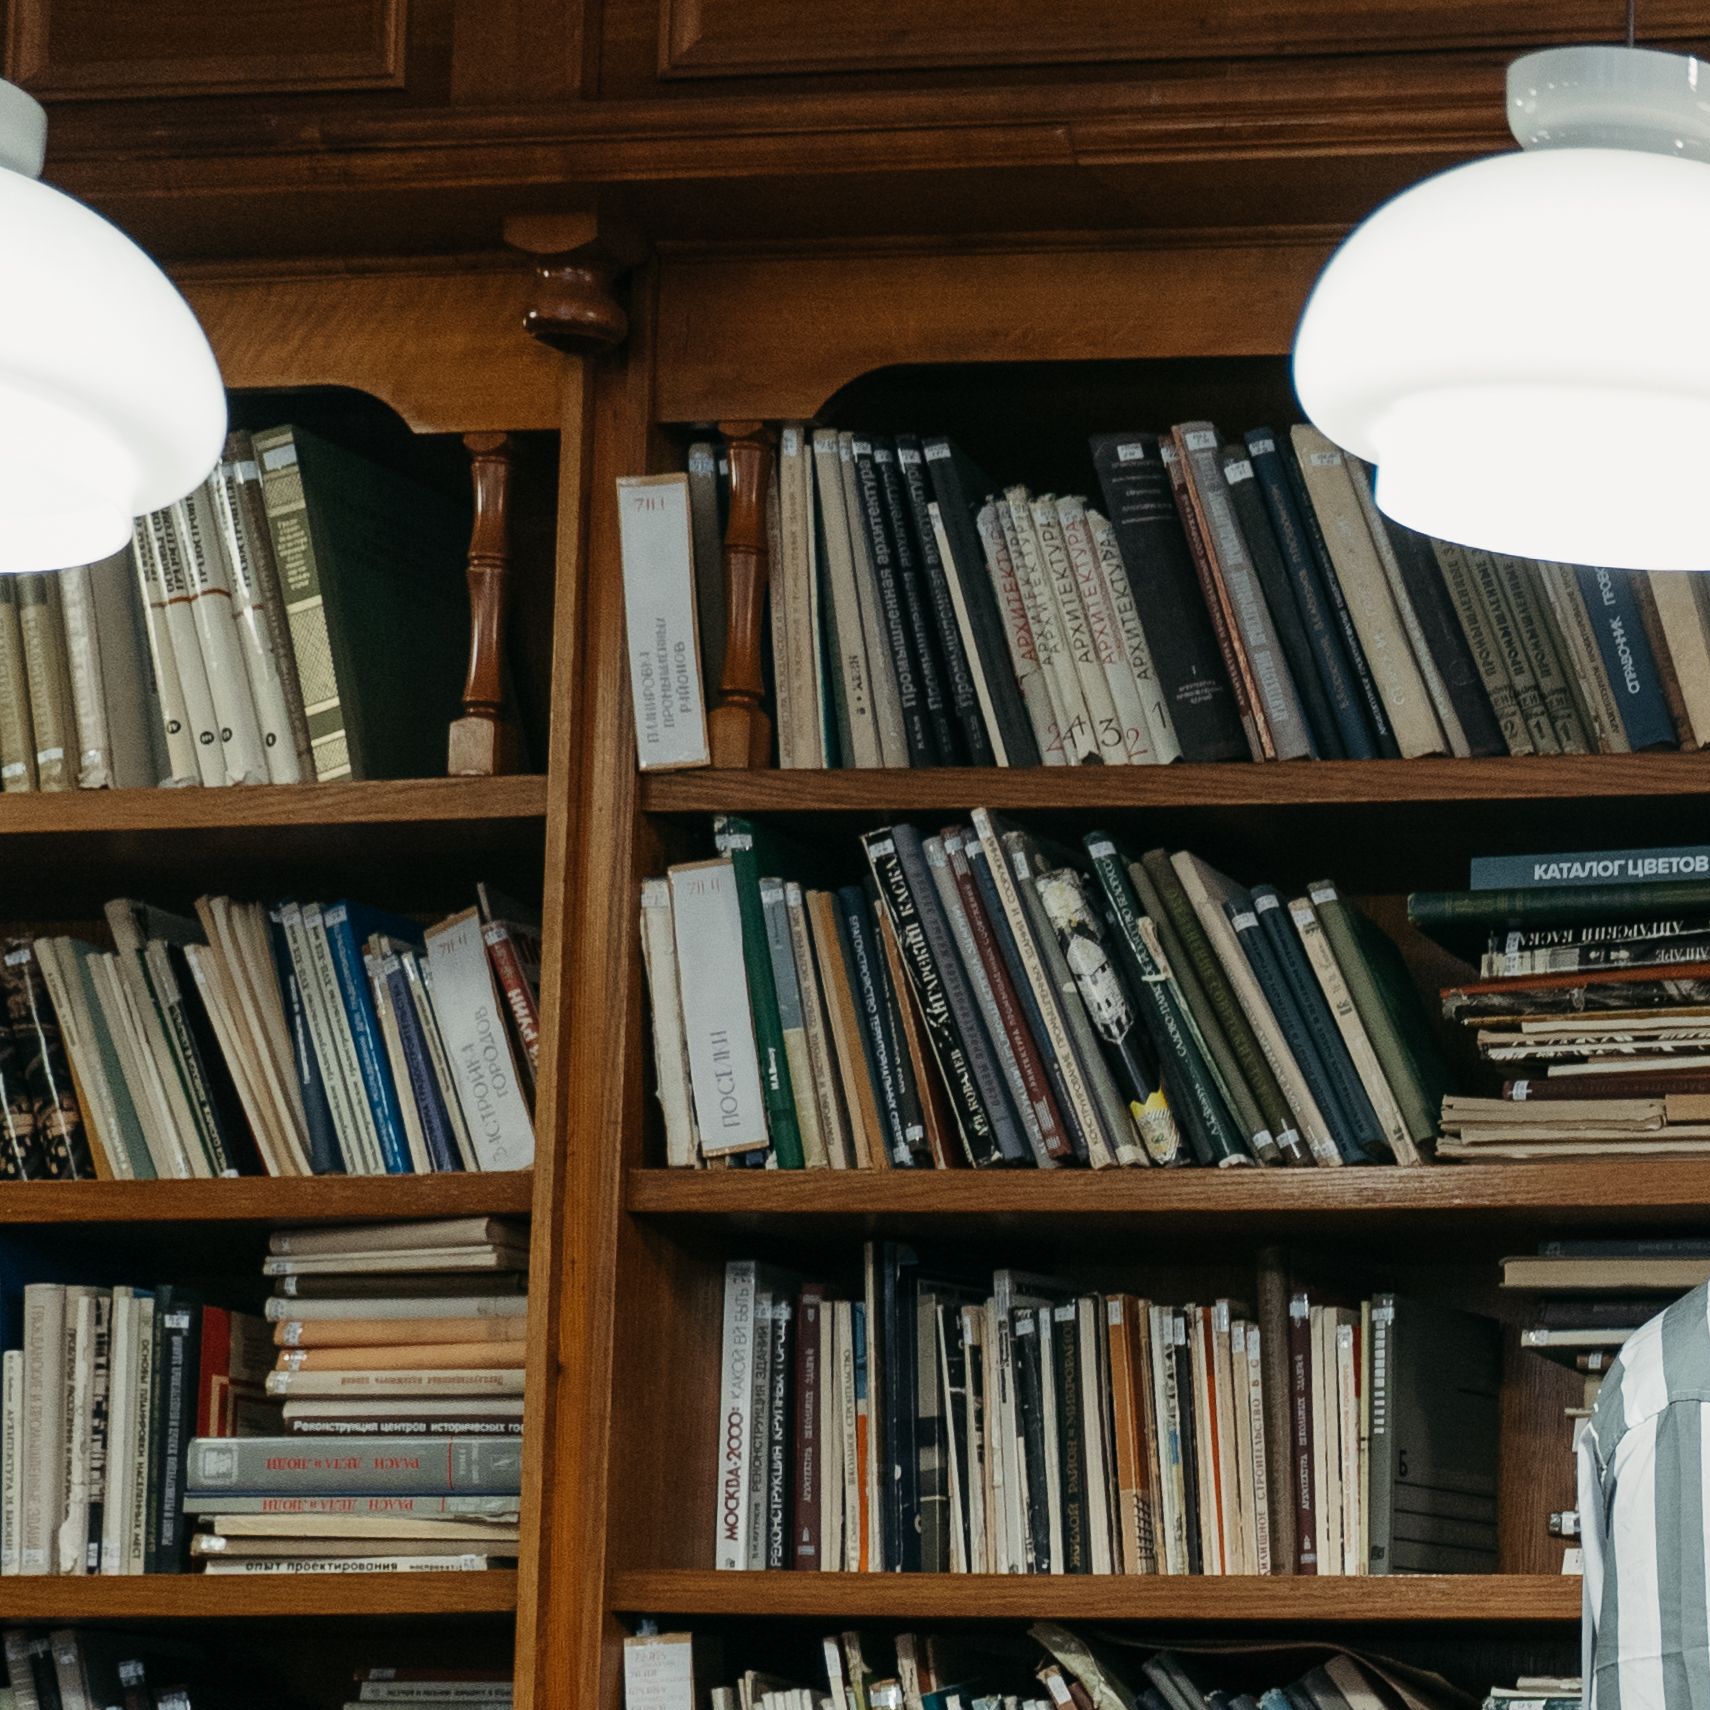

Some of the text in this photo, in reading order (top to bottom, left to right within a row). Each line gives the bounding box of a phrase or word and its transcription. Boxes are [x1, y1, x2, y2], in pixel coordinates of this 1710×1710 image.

[879, 568, 918, 709] Промышленная
[1099, 537, 1152, 681] АРХИТЕКТУРА
[1447, 559, 1497, 676] ПРОМЫШЛЕННЫЕ
[1475, 560, 1525, 676] ПРОМЫШЛЕННЫЕ
[1609, 616, 1641, 694] СПРАВОЧНИК
[1533, 860, 1624, 881] КАТАЛОГ
[1627, 855, 1709, 878] ЦВЕТОВ
[293, 1420, 378, 1434] Реконструкция
[380, 1421, 426, 1434] центров
[751, 1325, 769, 1493] РЕКОНСТРУКЦИЯ ЗДАНИЙ
[1250, 1397, 1269, 1501] СТРОИТЕЛЬСТВО
[769, 1372, 786, 1567] РЕКОНСТРУКЦИЯ КРУПНЫХ
[1064, 1439, 1080, 1494] РАЙОН
[287, 1560, 398, 1572] проектирования
